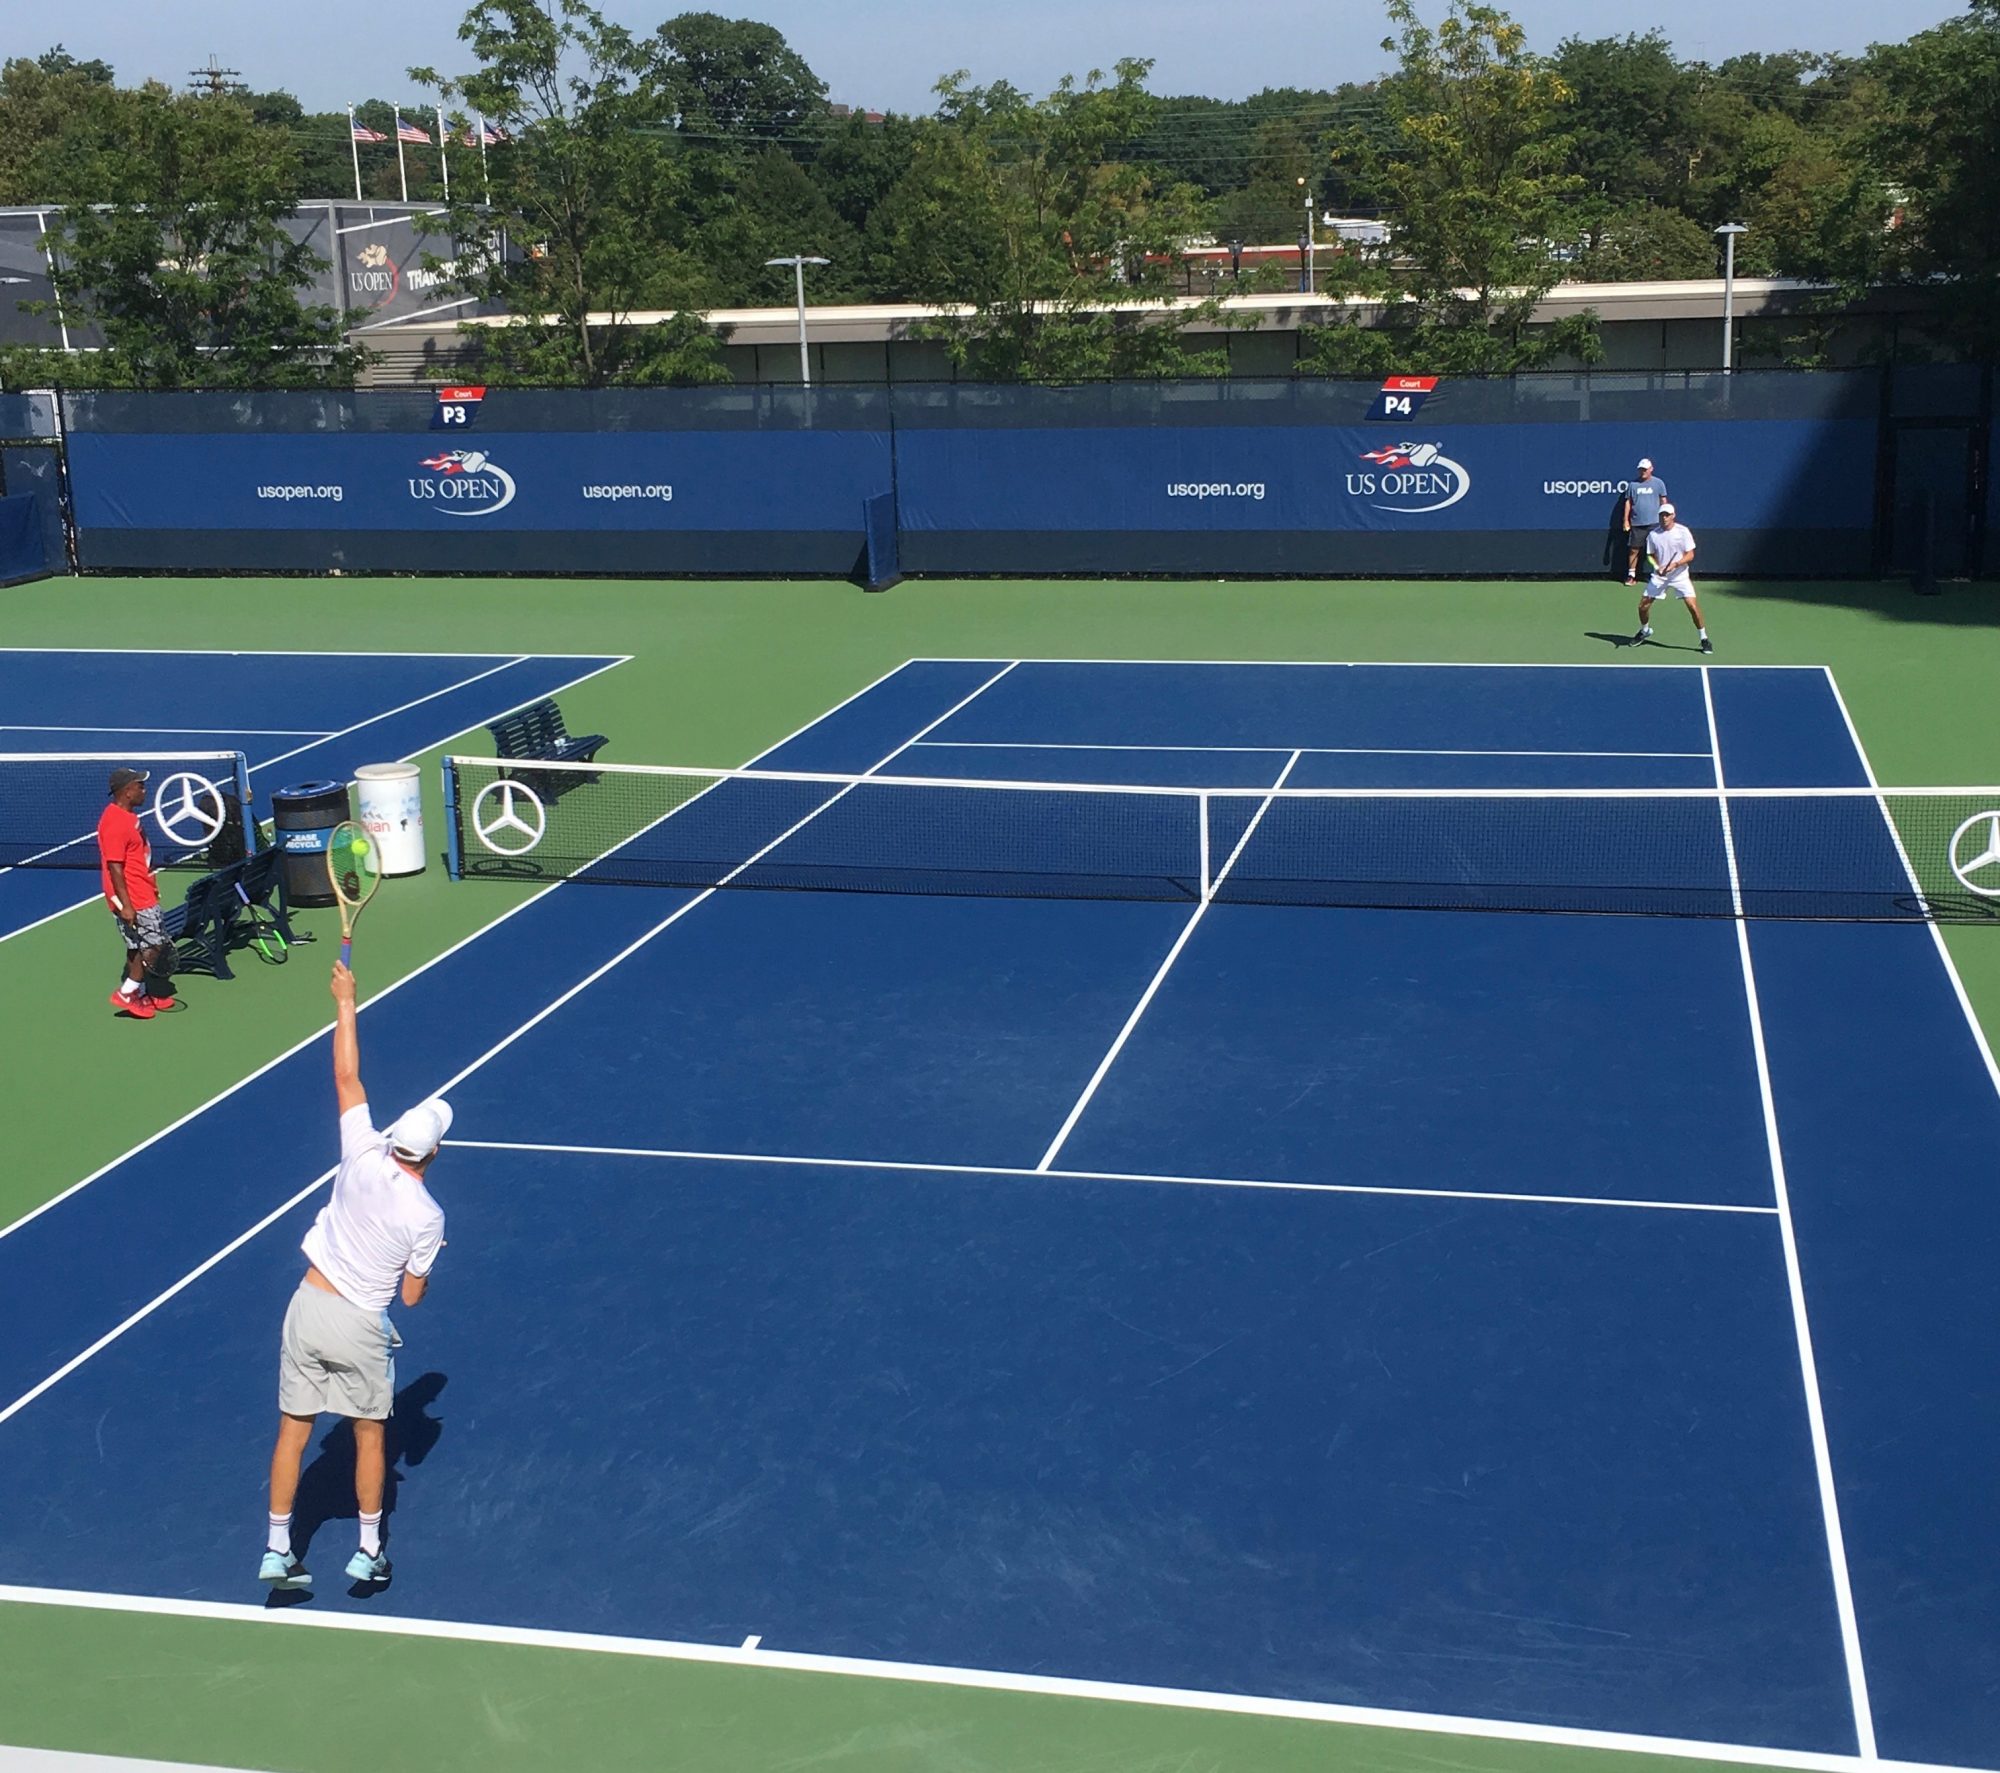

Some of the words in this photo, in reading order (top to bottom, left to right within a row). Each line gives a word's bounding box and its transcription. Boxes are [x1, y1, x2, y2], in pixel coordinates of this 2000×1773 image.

[351, 272, 363, 291] US
[364, 271, 392, 291] OPEN
[1400, 379, 1421, 388] Court
[454, 390, 472, 398] Court
[443, 405, 466, 424] P3
[1385, 396, 1412, 415] P4
[257, 485, 343, 501] usopen.org
[408, 479, 435, 498] US
[439, 478, 500, 499] OPEN
[583, 485, 673, 501] usopen.org
[1167, 483, 1265, 500] usopen.org
[1345, 473, 1376, 495] US
[1381, 473, 1452, 495] OPEN
[1543, 480, 1629, 498] usopen.o
